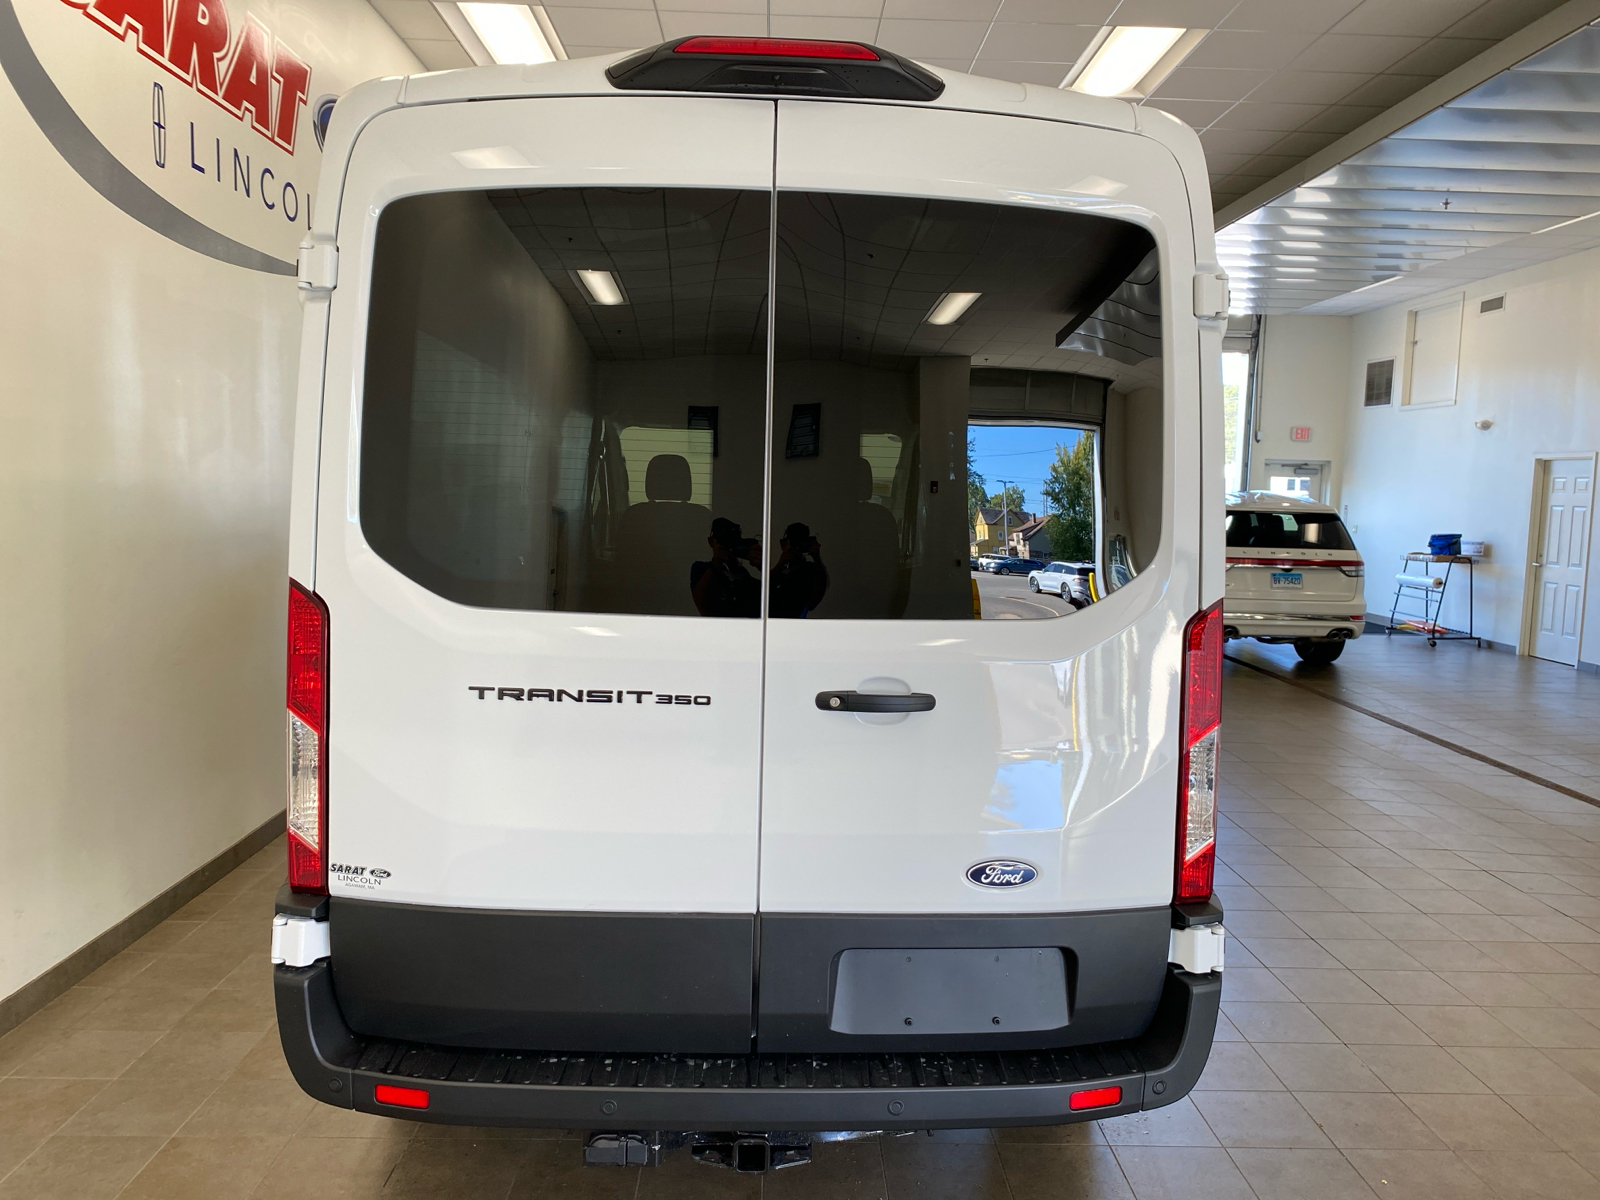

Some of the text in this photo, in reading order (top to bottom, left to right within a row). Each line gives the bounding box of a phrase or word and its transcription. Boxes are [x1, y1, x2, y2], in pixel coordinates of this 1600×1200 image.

[60, 0, 312, 155] ARAT
[190, 121, 312, 231] LINCOL
[1295, 427, 1310, 439] EXIT
[468, 686, 712, 706] TRANSIT 350
[330, 863, 367, 876] SARAT
[981, 865, 1024, 884] Ford
[338, 875, 381, 886] LINCOLN
